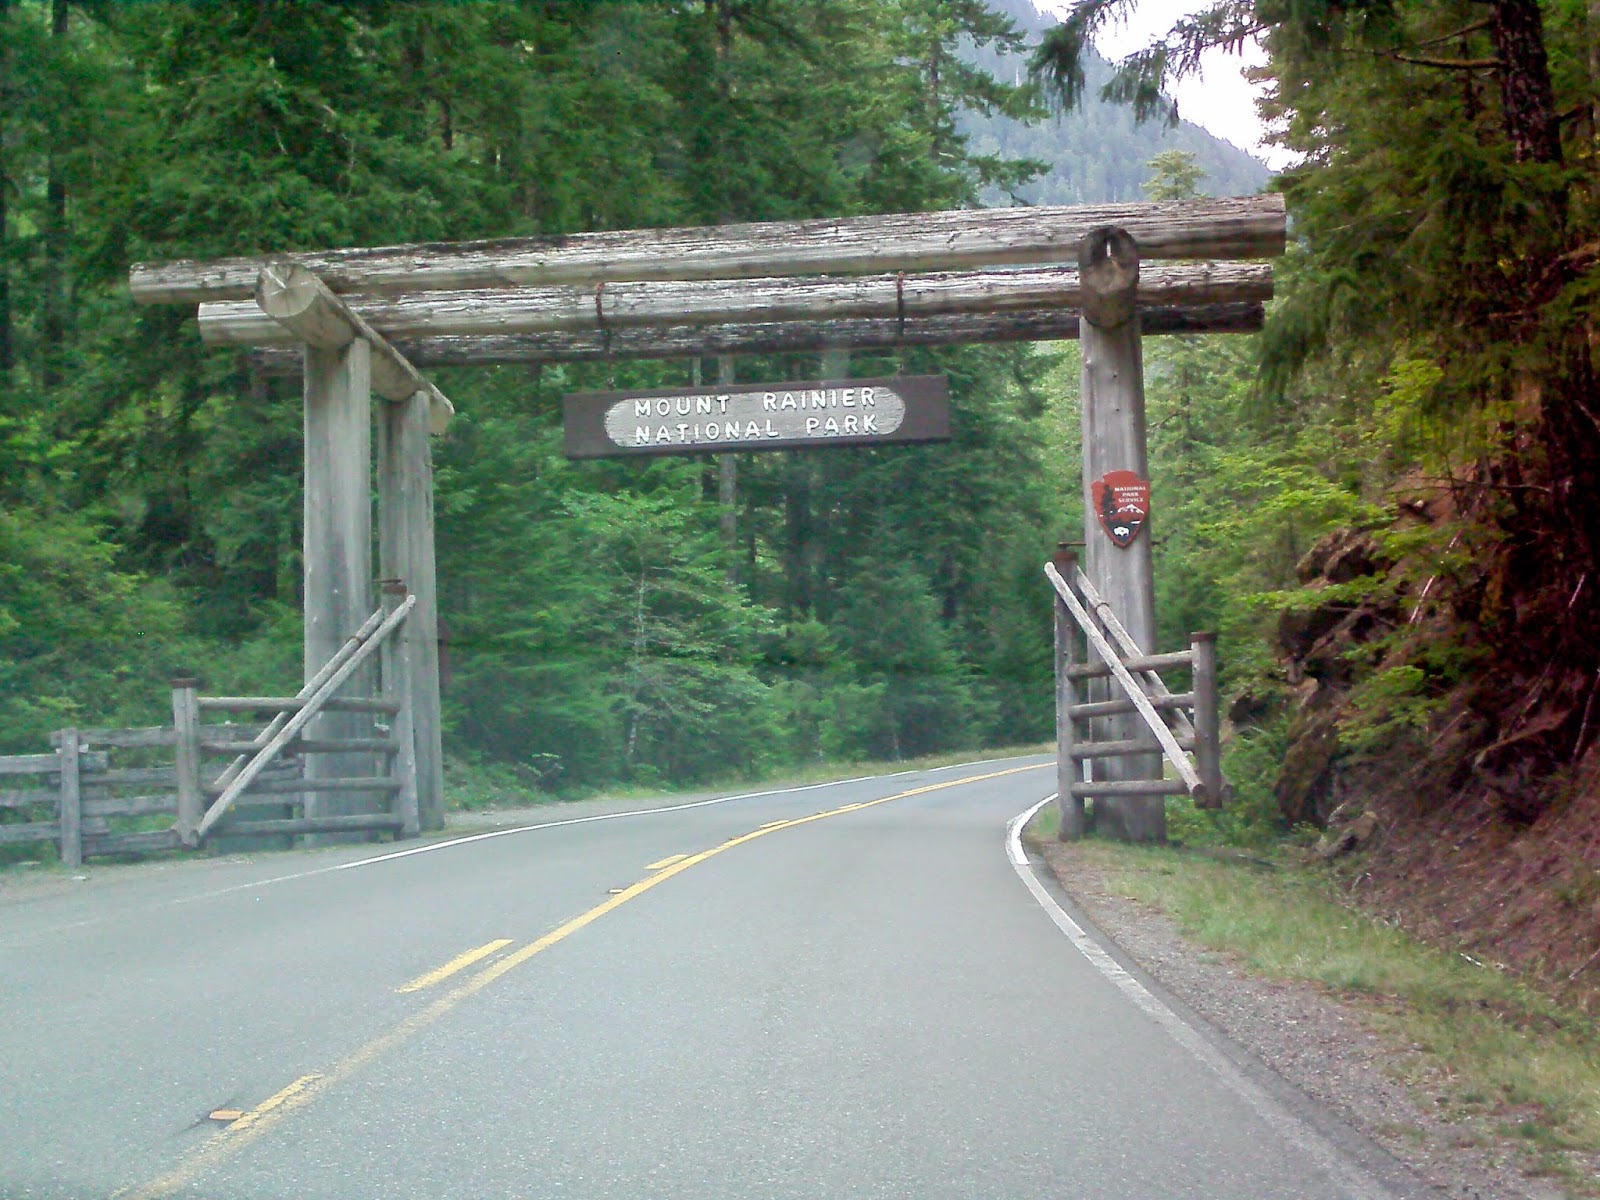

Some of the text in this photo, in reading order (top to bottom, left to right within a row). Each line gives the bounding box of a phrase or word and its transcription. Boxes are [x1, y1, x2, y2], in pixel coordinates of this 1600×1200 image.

[634, 387, 876, 418] MOUNT RAINIER
[634, 414, 878, 445] NATIONAL PARK
